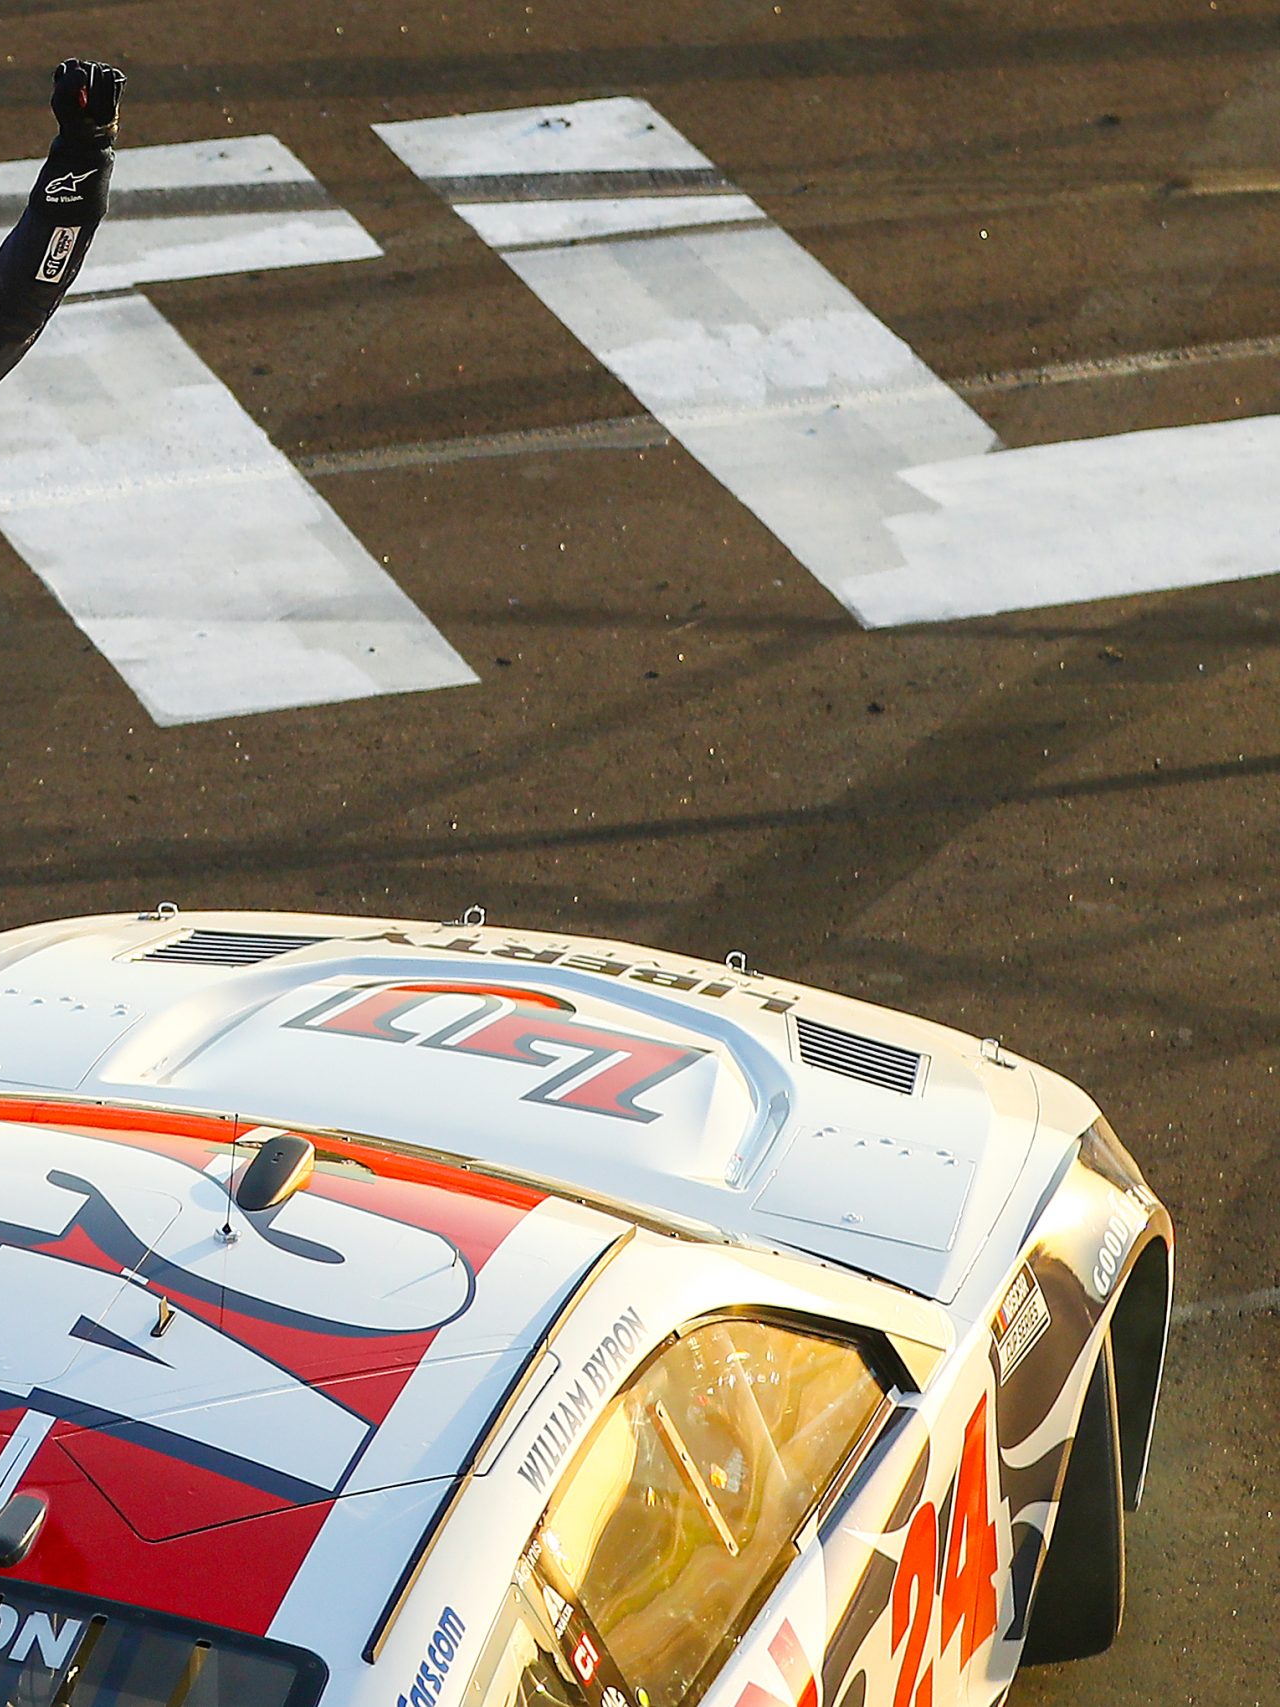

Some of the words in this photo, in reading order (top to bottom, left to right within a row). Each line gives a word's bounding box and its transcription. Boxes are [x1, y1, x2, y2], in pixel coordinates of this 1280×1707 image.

[345, 930, 797, 1014] LIBERTY
[517, 1379, 594, 1494] WILLIAM
[581, 1306, 648, 1399] BYRON
